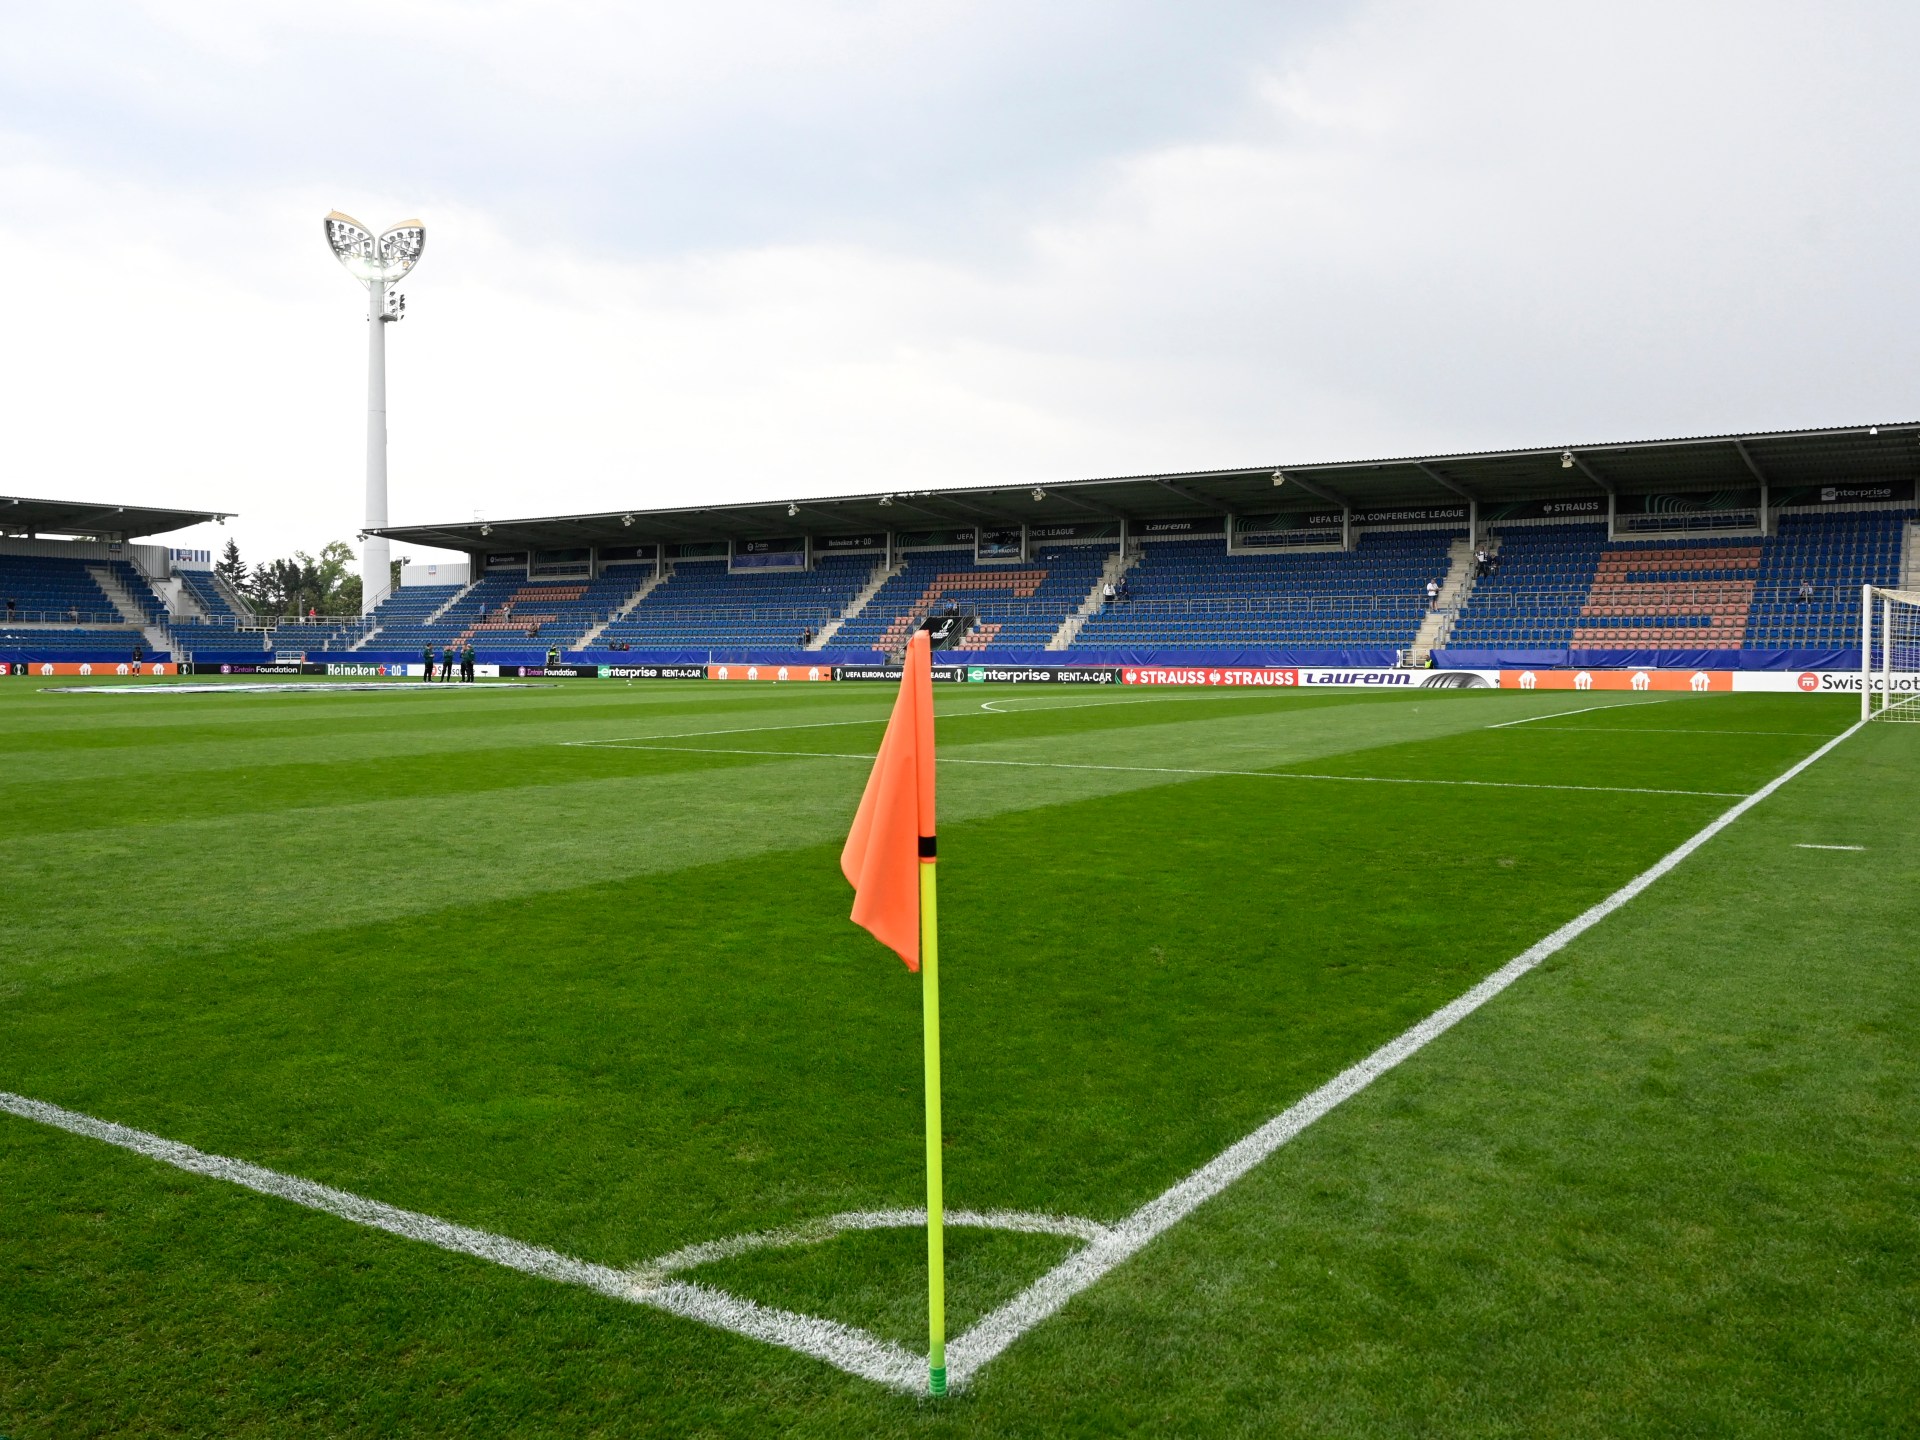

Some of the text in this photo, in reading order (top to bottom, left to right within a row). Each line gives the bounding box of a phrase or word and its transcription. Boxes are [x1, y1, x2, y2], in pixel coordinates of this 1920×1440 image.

[1554, 502, 1599, 512] STRAUSS
[1309, 509, 1465, 524] UEFA EUOPA CONFERENCE LEAGUE
[1047, 528, 1075, 536] LEAGUE
[256, 665, 298, 673] Foundation
[327, 664, 376, 675] Heineken
[544, 667, 577, 676] Foundation
[601, 667, 700, 678] enterprise RENT-A-CAR
[972, 669, 1112, 683] enterprise RENT-A-CAR
[1140, 671, 1294, 685] STRAUSS STRAUSS
